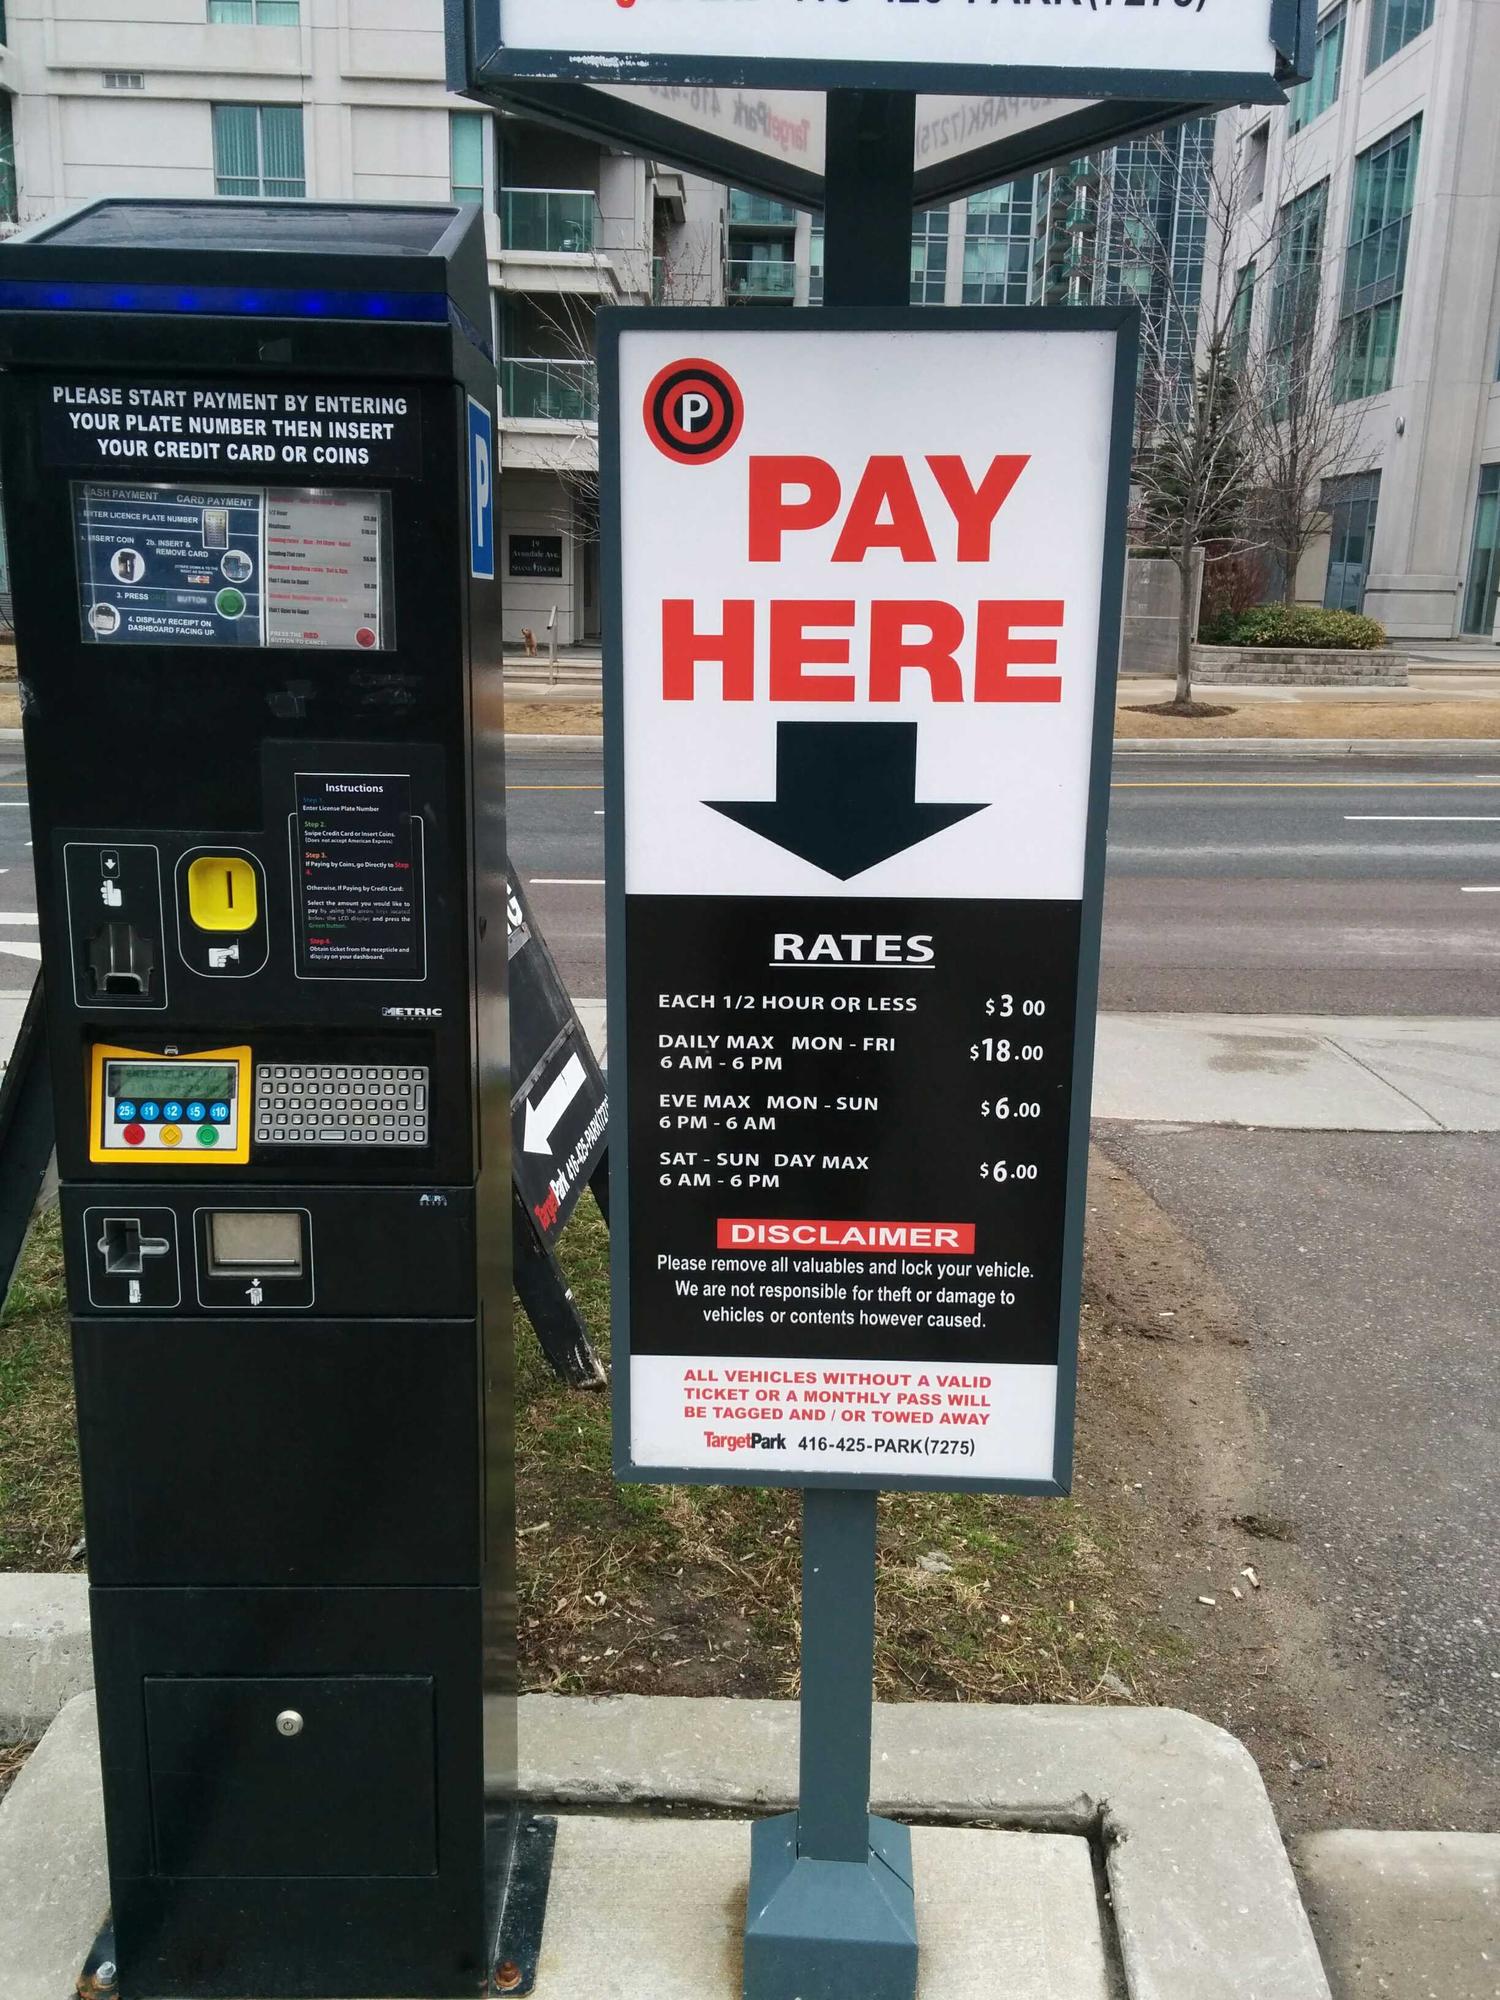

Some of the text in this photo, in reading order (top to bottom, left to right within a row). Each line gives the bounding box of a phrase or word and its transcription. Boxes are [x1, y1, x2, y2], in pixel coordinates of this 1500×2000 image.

[53, 386, 408, 415] PLEASE START PAYMENT BY ENTERING
[681, 393, 709, 434] P
[69, 412, 395, 440] YOUR PLATE NUMBER THEN INSERT
[97, 438, 370, 465] YOUR CREDIT CARD OR COINS
[112, 489, 160, 501] PAYMENT
[475, 433, 489, 547] P
[176, 494, 254, 507] CARD PAYMENT
[748, 454, 1032, 563] PAY
[110, 511, 141, 521] LICENCE
[142, 513, 166, 523] PLATE
[167, 514, 199, 524] NUMBER
[116, 536, 135, 544] COIN
[158, 539, 185, 549] INSERT
[156, 547, 209, 558] REMOVE CARD
[116, 592, 123, 600] 3.
[124, 593, 149, 601] PRESS
[128, 624, 174, 634] DASHBOARD
[176, 626, 203, 635] FACING
[136, 616, 167, 625] DISPLAY
[168, 618, 199, 627] RECEIPT
[661, 599, 1065, 703] HERE
[325, 783, 384, 793] Instructions
[774, 933, 935, 963] RATES
[382, 1006, 443, 1017] METRIC
[658, 994, 918, 1012] EACH 1/2 HOUR OR LESS
[658, 1034, 896, 1051] DAILY MAX MON FRI
[969, 1038, 1044, 1062] $18.00
[660, 1055, 783, 1071] 6 AM 6 PM
[659, 1094, 879, 1111] EVE MAX MON SUN
[981, 1096, 1041, 1119] $6.00
[659, 1116, 777, 1131] 6 PM 6 AM
[659, 1152, 870, 1170] SAT SUN DAY MAX
[659, 1173, 780, 1188] 6 AM 6 PM
[979, 1160, 1038, 1183] $6.00
[731, 1224, 960, 1248] DISCLAIMER
[657, 1254, 1035, 1280] Please remove all valuables and lock your vehicle.
[675, 1279, 1016, 1308] We are not responsible for theft or damage to
[703, 1306, 987, 1328] vehicles or contents however caused.
[683, 1369, 992, 1389] ALL VEHICLES WITHOUT A VALID
[683, 1387, 992, 1407] TICKET OR A MONTHLY PASS WILL
[684, 1406, 991, 1425] BE TAGGED AND OR TOWED AWAY
[703, 1431, 976, 1457] TargetPark 416-425-PARK(7275)
